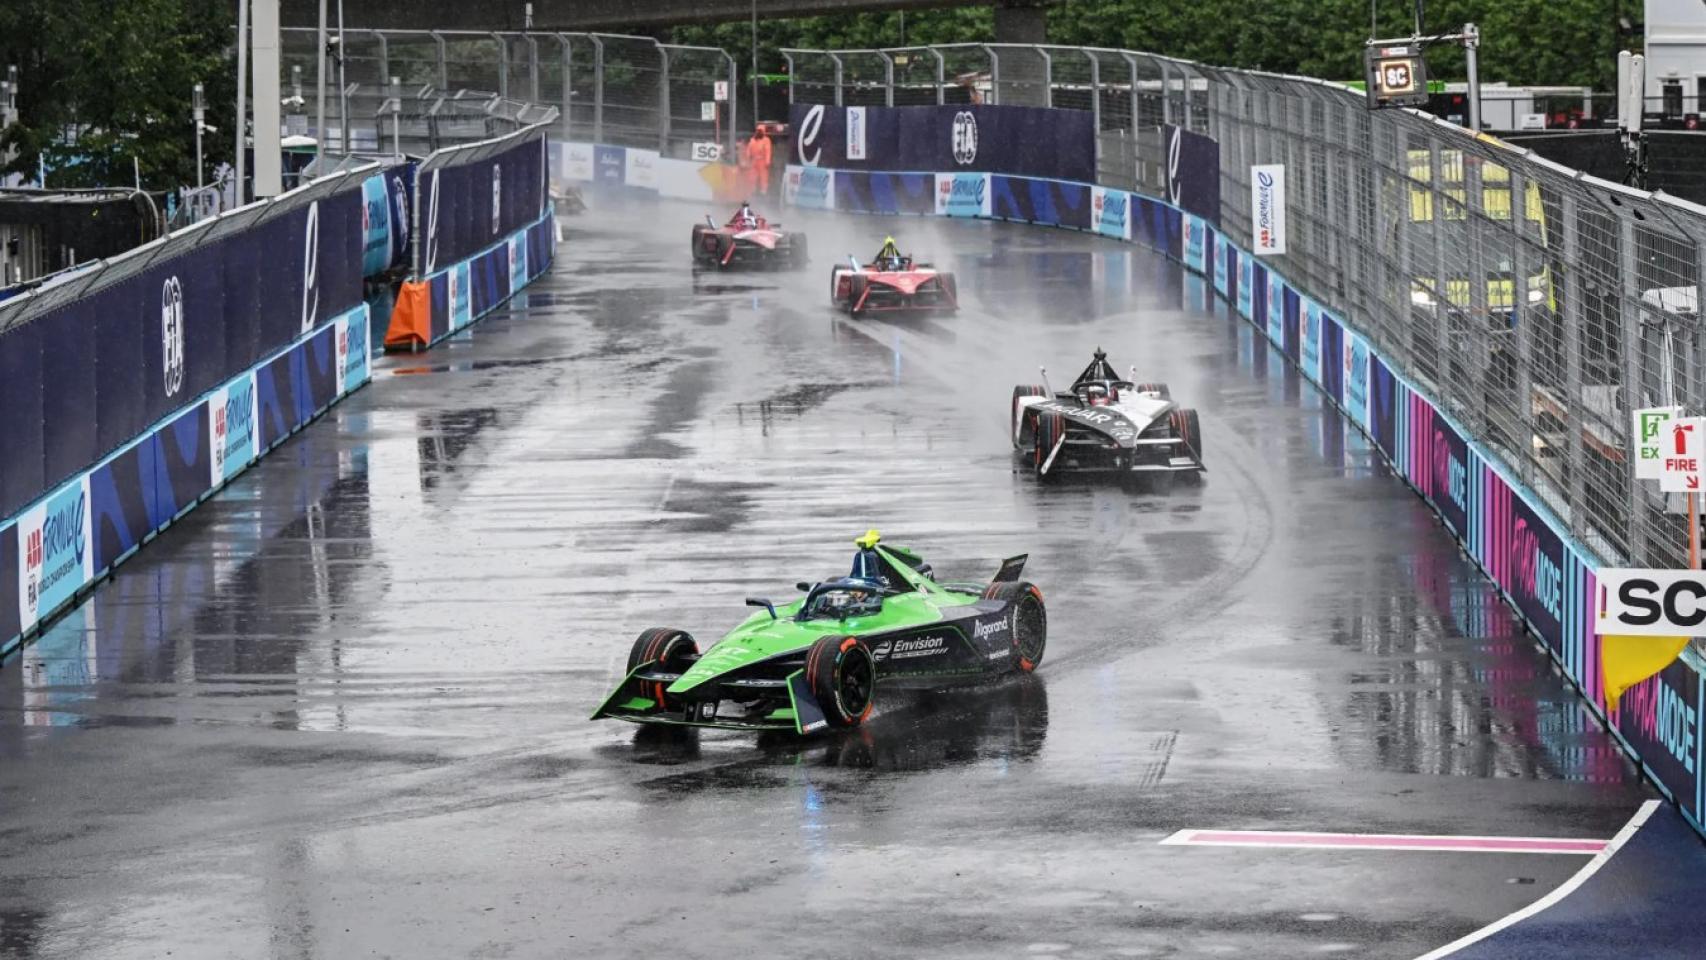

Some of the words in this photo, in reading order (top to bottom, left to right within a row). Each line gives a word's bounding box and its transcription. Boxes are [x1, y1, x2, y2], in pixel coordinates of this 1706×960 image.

[1386, 67, 1408, 86] SC
[697, 146, 718, 159] SC
[1259, 186, 1270, 229] FORMULA
[1260, 229, 1269, 248] ABB
[1665, 459, 1697, 472] FIRE
[1534, 545, 1561, 623] MODE
[1617, 578, 1706, 627] SC
[893, 636, 944, 652] Envision
[1655, 674, 1696, 774] MODE
